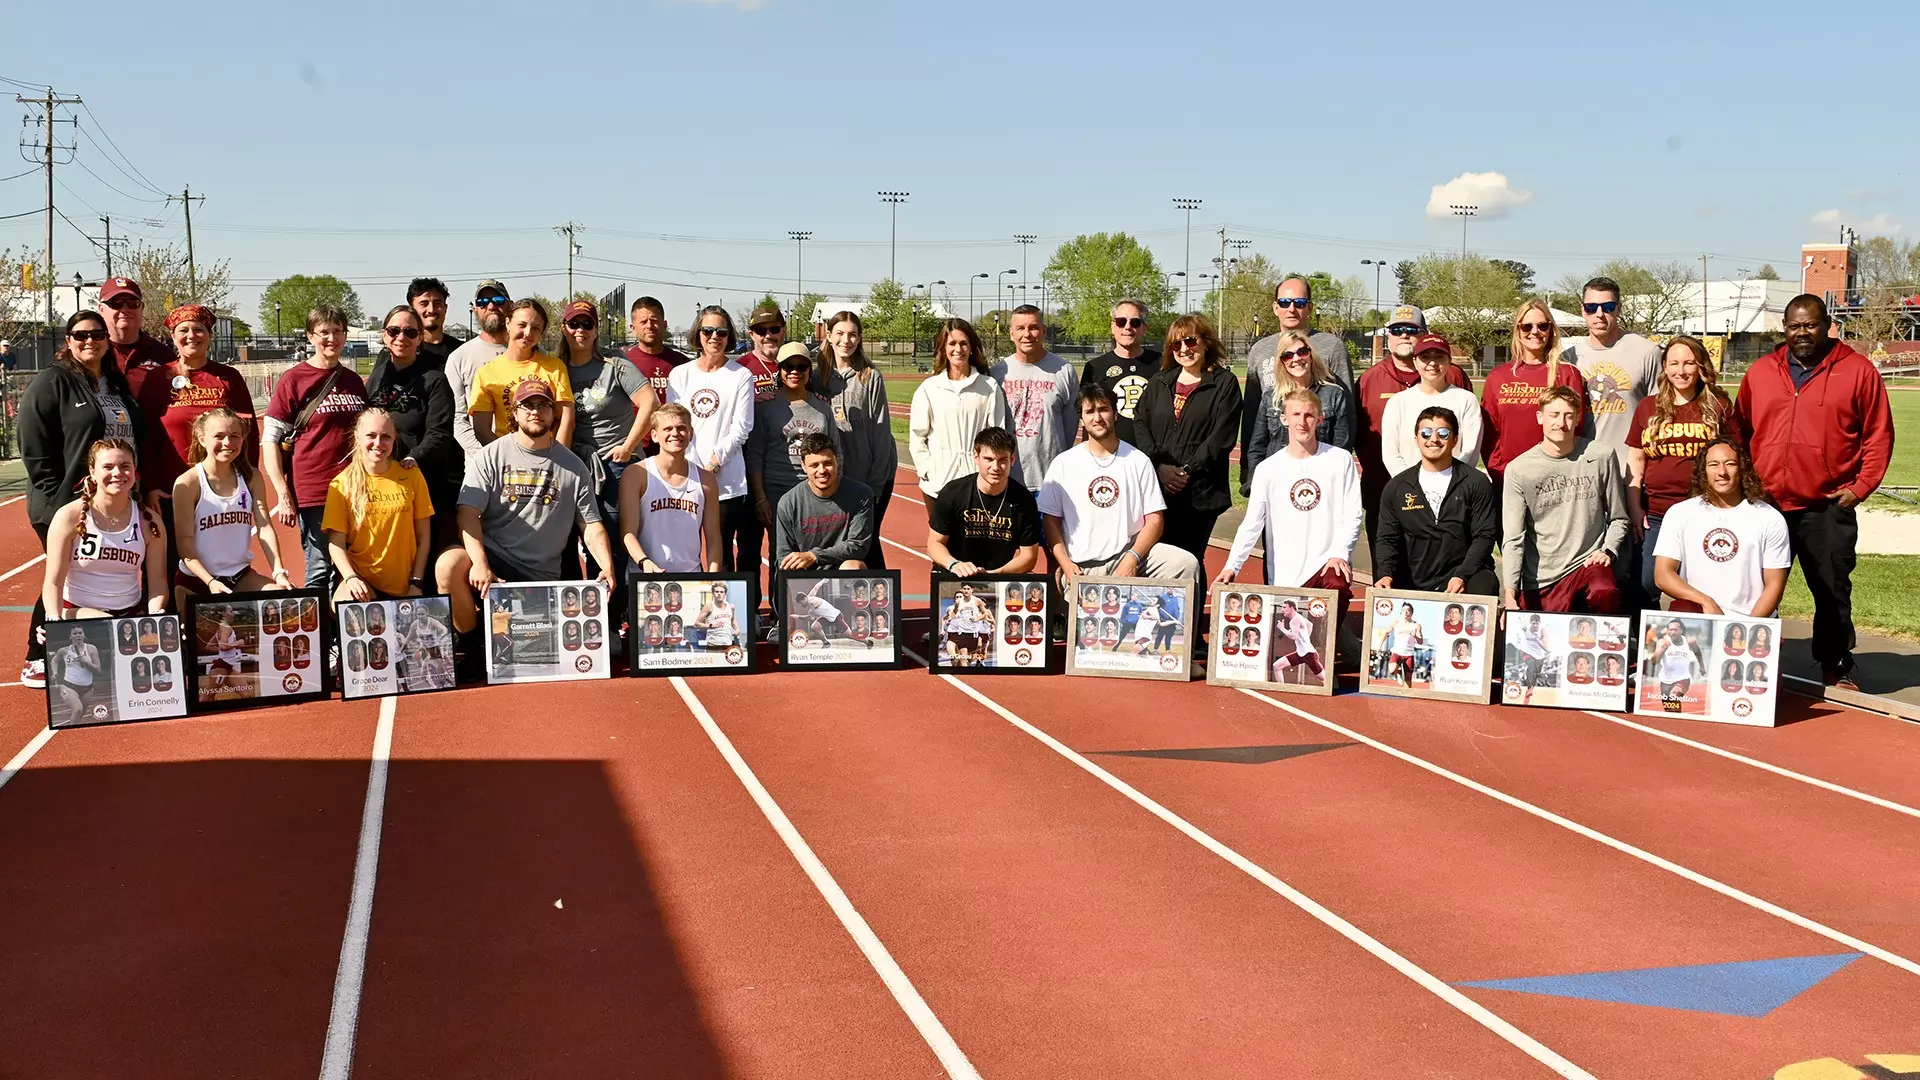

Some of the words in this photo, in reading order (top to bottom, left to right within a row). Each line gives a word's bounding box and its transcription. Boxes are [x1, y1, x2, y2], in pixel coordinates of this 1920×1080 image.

[1583, 360, 1633, 392] LISBURY
[170, 384, 225, 399] Sisbury
[1500, 382, 1547, 394] Salisbur
[319, 393, 365, 407] LISBURY
[1124, 386, 1143, 409] B
[783, 420, 821, 434] ALISBUR
[1641, 422, 1712, 446] SAISBURY
[651, 498, 699, 514] SALISBURY
[200, 511, 252, 531] SALISBURY
[81, 533, 97, 556] 5
[73, 547, 140, 565] SISBURY
[643, 658, 660, 666] Sam
[661, 658, 692, 666] Bodmer
[693, 657, 713, 665] 2024
[809, 653, 834, 661] Temple
[372, 676, 388, 684] Dear
[199, 687, 223, 695] Alyssa
[224, 685, 253, 693] Santoro
[145, 697, 179, 706] Connelly
[1662, 701, 1680, 709] 2024
